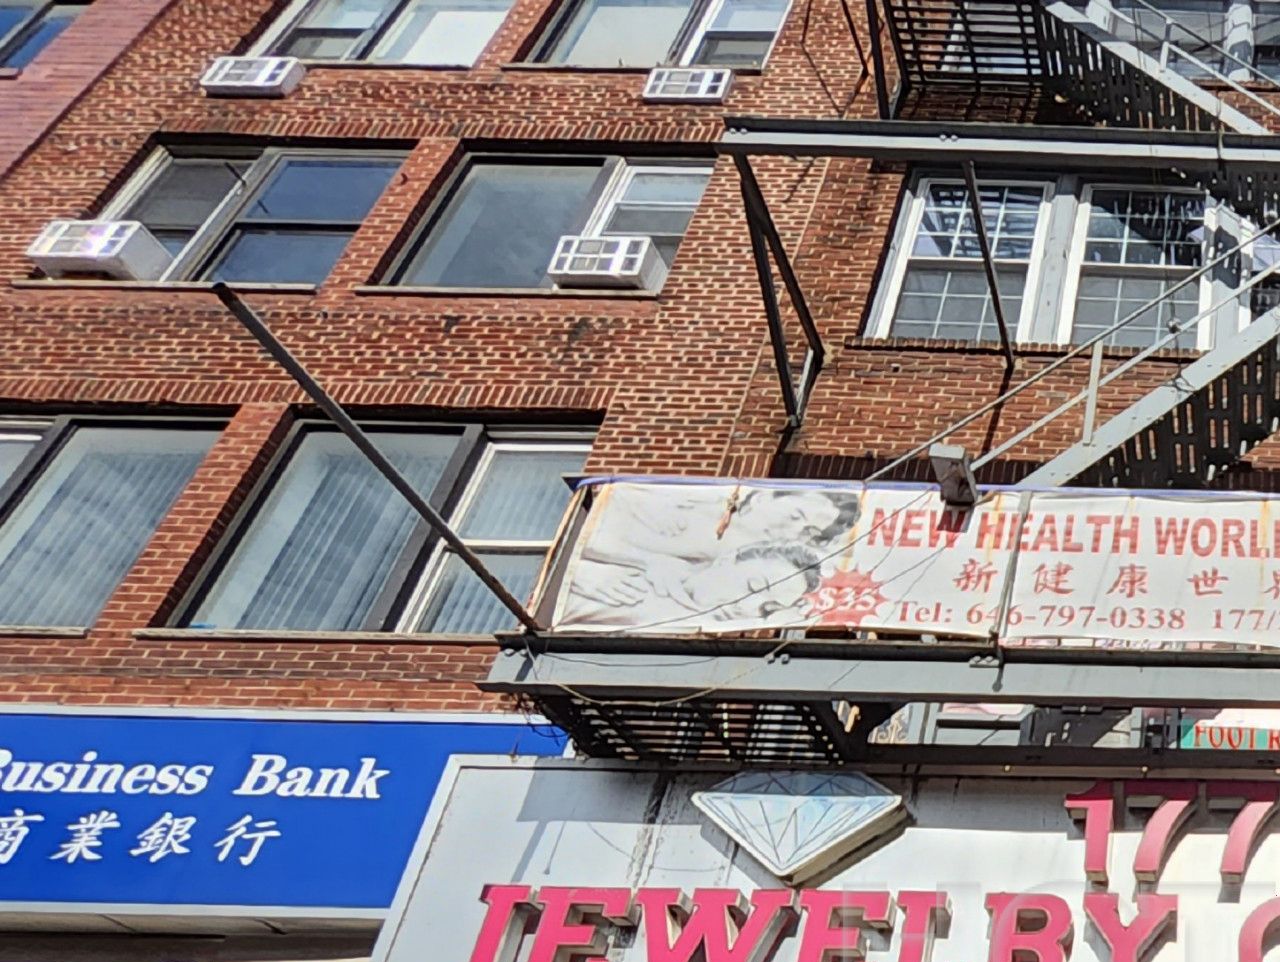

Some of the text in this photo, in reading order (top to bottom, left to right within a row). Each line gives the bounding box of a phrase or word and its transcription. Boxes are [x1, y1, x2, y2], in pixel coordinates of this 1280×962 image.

[866, 507, 967, 549] NEW
[975, 511, 1140, 554] HEALTH
[895, 600, 953, 623] Tel:
[0, 749, 391, 799] usiness Bank
[1065, 778, 1280, 880] 177
